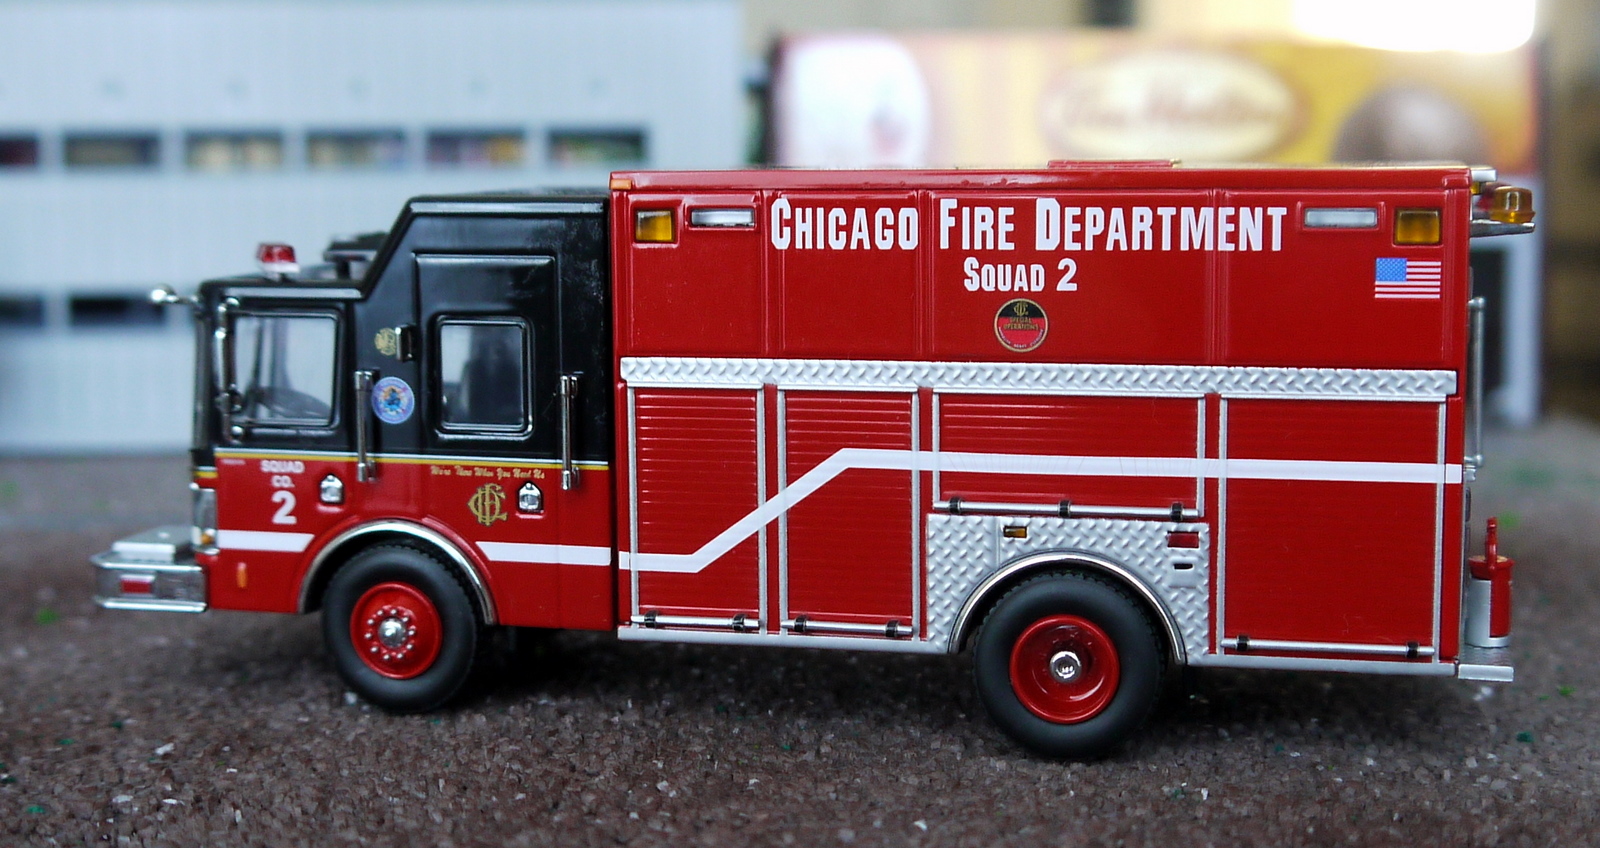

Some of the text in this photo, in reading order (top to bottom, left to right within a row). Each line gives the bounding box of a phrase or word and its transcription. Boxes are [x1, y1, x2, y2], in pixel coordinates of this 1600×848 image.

[770, 197, 1288, 252] CHICAGO FIRE DEPARTMENT
[963, 256, 1078, 292] SQUAD 2
[260, 459, 305, 474] SQUAD
[271, 490, 297, 525] 2
